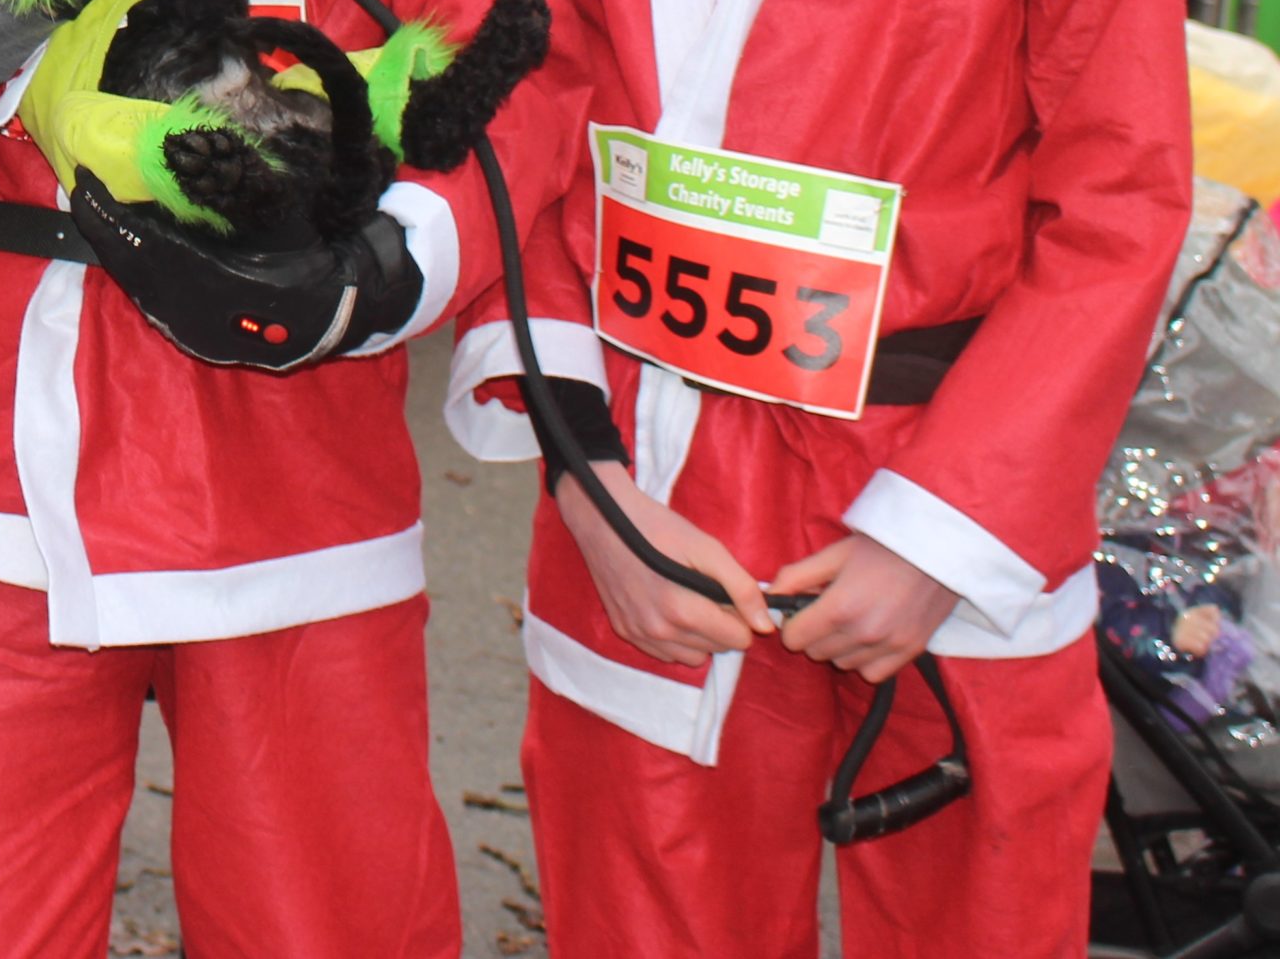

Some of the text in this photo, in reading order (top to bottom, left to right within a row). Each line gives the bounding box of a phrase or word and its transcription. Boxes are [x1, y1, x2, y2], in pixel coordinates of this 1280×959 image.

[669, 153, 801, 199] Kelly's Storage
[668, 182, 795, 226] Charity Events
[612, 235, 850, 372] 5553
